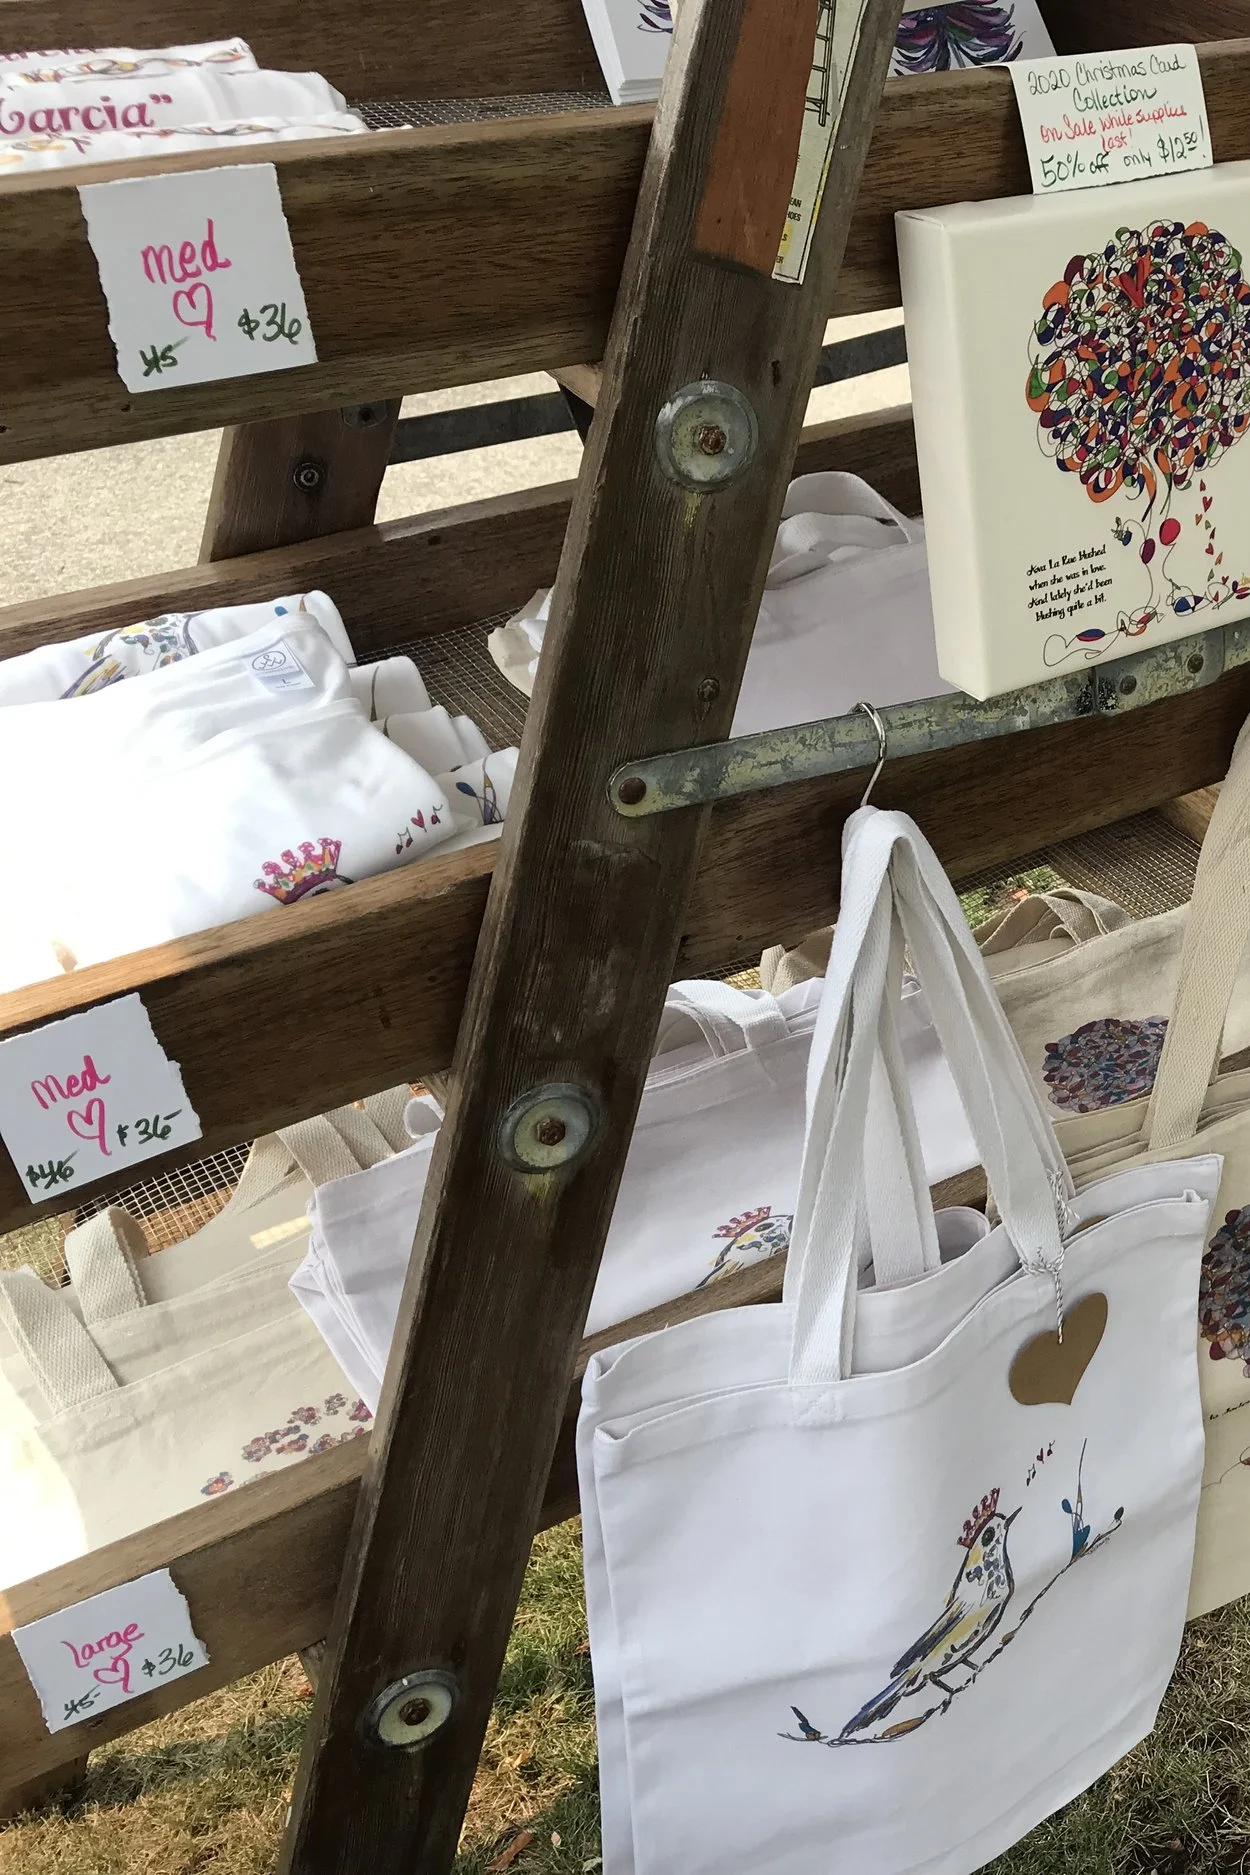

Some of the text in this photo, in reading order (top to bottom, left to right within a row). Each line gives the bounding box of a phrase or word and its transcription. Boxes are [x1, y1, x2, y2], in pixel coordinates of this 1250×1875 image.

[1028, 54, 1186, 95] 2020 Christmas Card
[1072, 85, 1157, 112] Collection
[1040, 151, 1086, 188] 50%
[1089, 151, 1110, 174] off
[1124, 150, 1152, 168] only
[237, 303, 302, 345] $36
[1028, 578, 1112, 608] And lately she'd been
[1029, 580, 1048, 591] when
[1050, 574, 1063, 585] she
[1065, 572, 1080, 580] was
[1082, 568, 1088, 576] in
[1036, 608, 1065, 621] blushing
[1067, 600, 1084, 616] quite
[141, 1643, 194, 1677] $36
